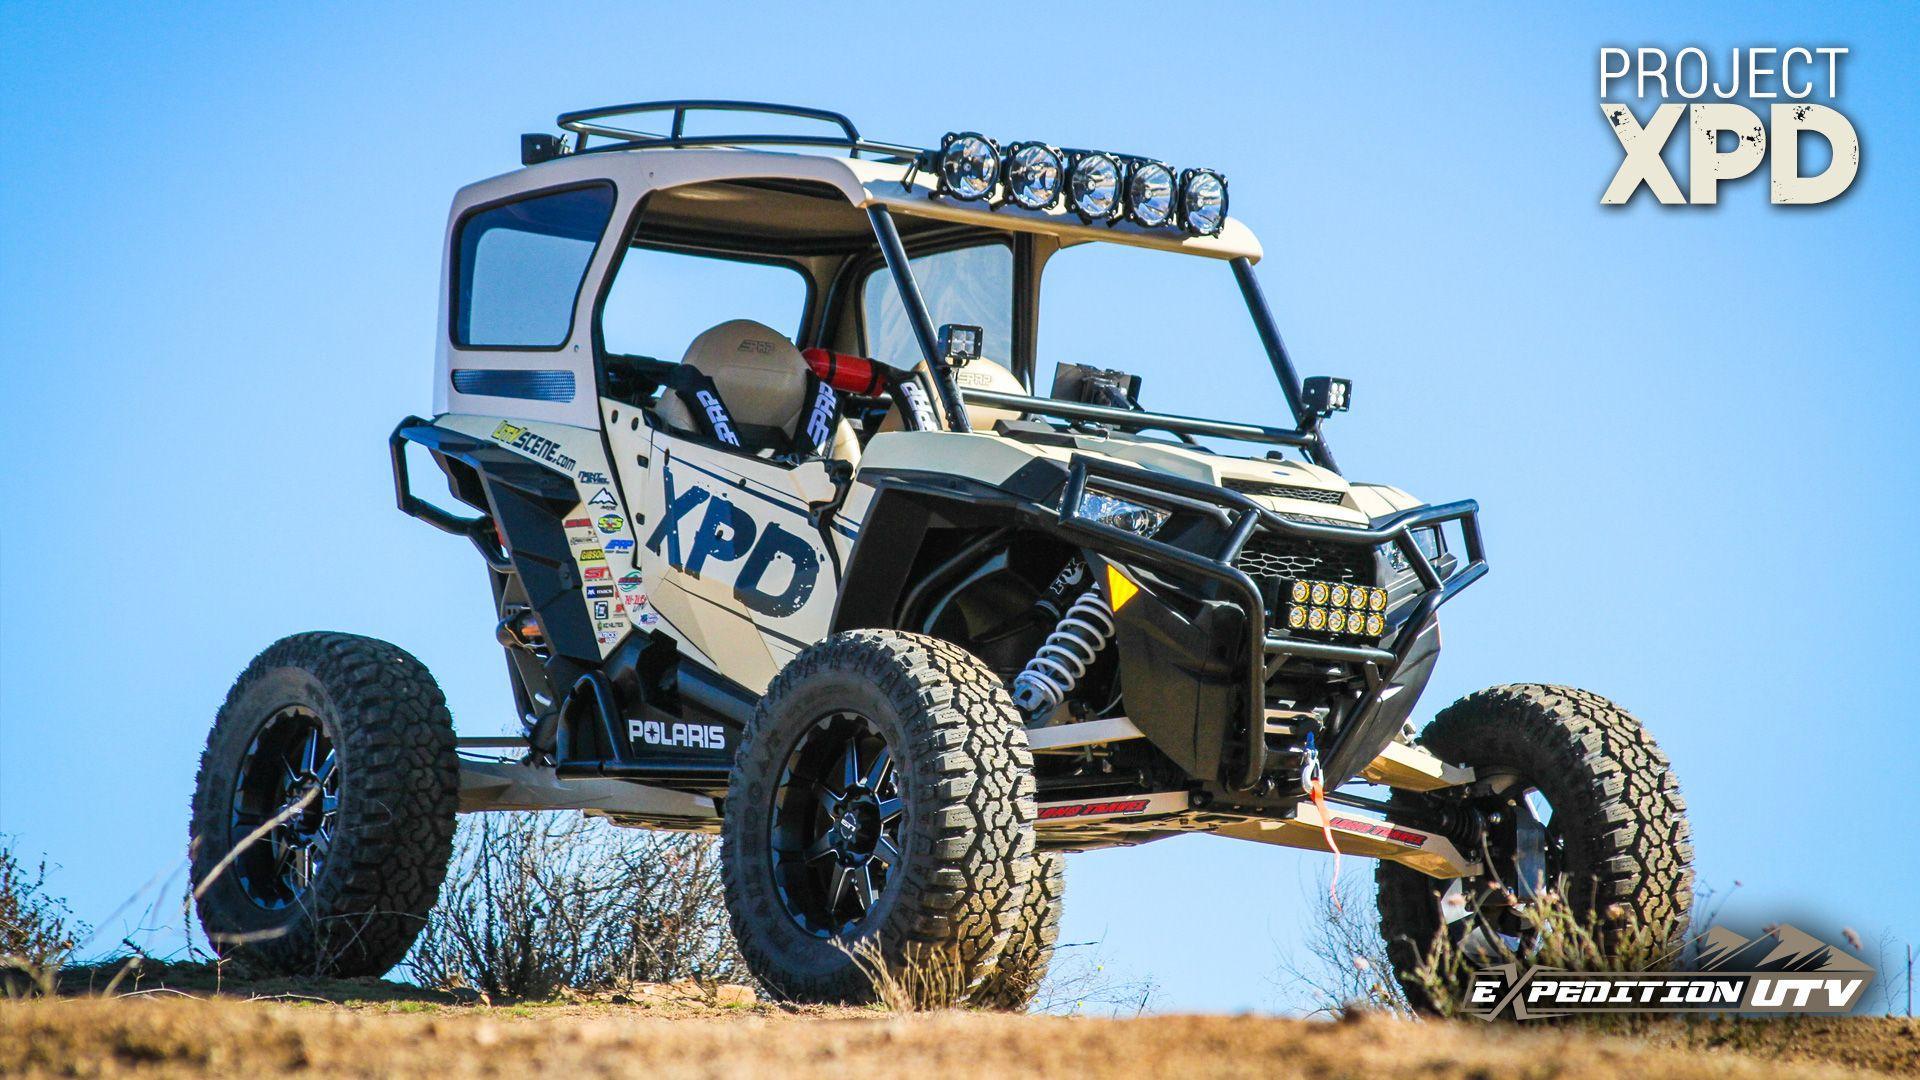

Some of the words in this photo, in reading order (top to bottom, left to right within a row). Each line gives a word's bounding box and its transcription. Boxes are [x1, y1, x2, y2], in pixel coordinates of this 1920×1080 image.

[645, 465, 820, 618] XPD
[628, 719, 726, 750] POLARIS
[1079, 799, 1150, 815] TRAVEL
